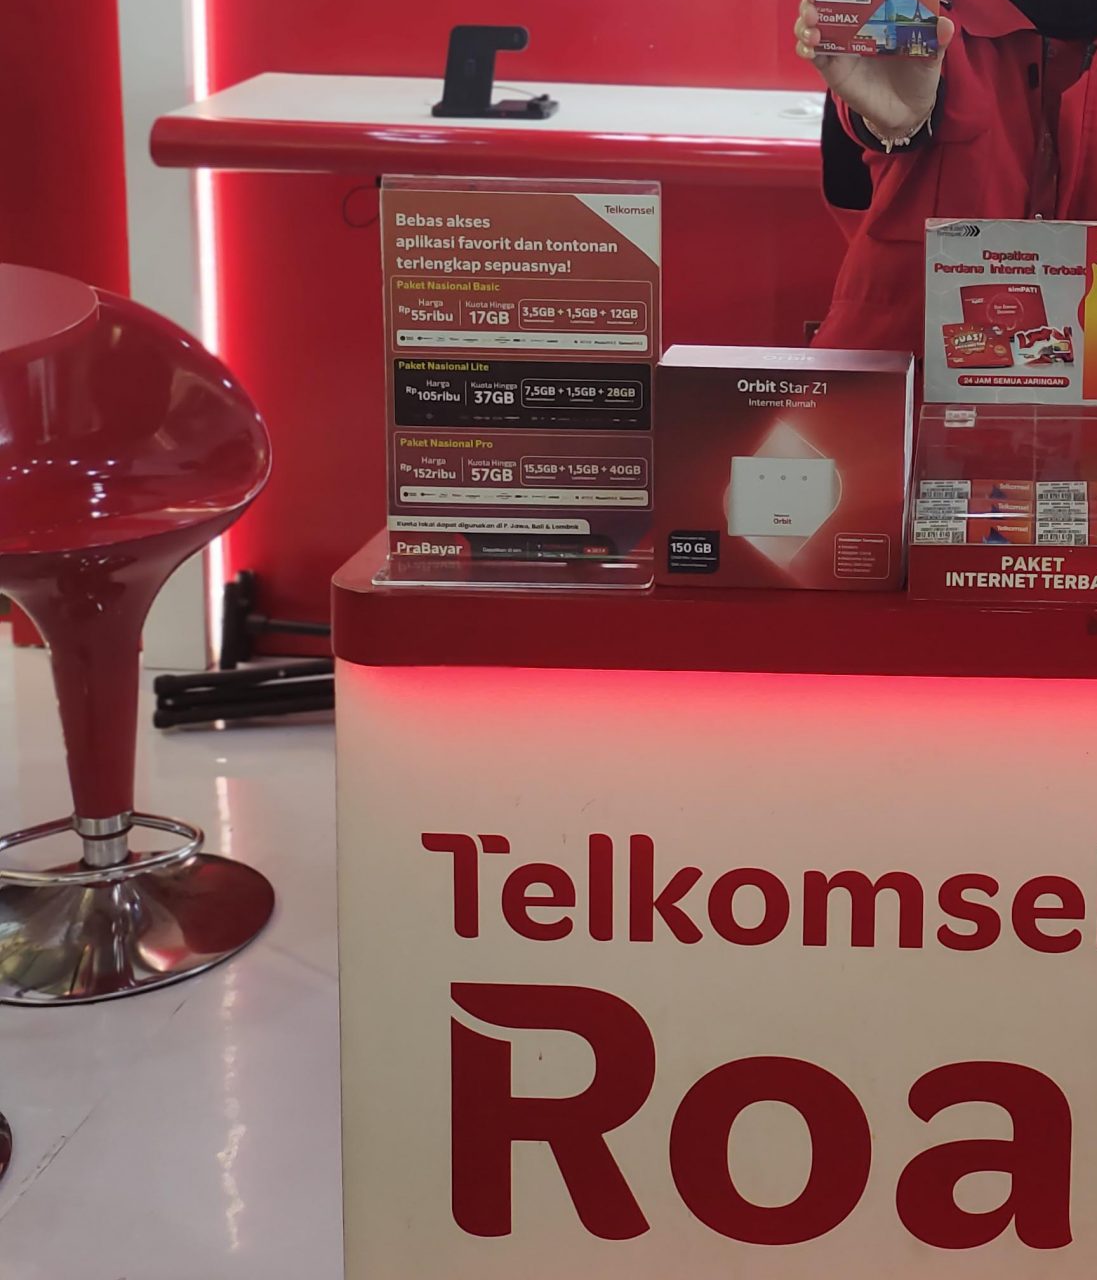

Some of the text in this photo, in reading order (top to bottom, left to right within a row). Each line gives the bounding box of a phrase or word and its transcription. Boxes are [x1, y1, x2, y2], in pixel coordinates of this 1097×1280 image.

[604, 205, 655, 215] Telkomsel
[395, 213, 491, 228] Bebas akses
[395, 235, 618, 253] aplikasi favorit dan tontonan
[982, 250, 1039, 263] Dapatkan
[396, 256, 571, 275] terlengkap sepuasnya!
[934, 263, 984, 274] Perdana
[990, 263, 1036, 274] Internet
[397, 280, 500, 291] Paket Nasional Basic
[1008, 286, 1037, 294] simPATI
[418, 299, 444, 308] Harga
[489, 301, 515, 310] Hingga
[398, 306, 454, 322] Rp 55ribu
[469, 311, 510, 325] 17GB
[522, 306, 639, 319] 3,5GB 1,5GB 12GB
[398, 361, 489, 371] Paket Nasional Lite
[426, 380, 450, 389] Harga
[494, 382, 518, 390] Hingga
[737, 379, 827, 395] Orbit Star Z1
[993, 377, 1022, 385] SEMUA
[1023, 377, 1064, 386] JARINGAN
[405, 386, 460, 402] Rp 105ribu
[524, 385, 636, 397] 7,5GB 1,5GB 28GB
[474, 391, 515, 404] 37GB
[748, 398, 816, 408] Internet Rumah
[400, 438, 493, 448] Paket Nasional Pro
[421, 456, 447, 466] Harga
[491, 459, 517, 468] Hingga
[400, 463, 456, 479] Rp 152ribu
[471, 468, 513, 482] 57GB
[524, 464, 641, 475] 15,5GB 1,5GB 40GB
[773, 517, 792, 525] Orbit
[397, 542, 463, 557] PraBayar
[670, 542, 712, 553] 150 GB
[1001, 556, 1065, 572] PAKET
[946, 571, 1038, 589] INTERNET
